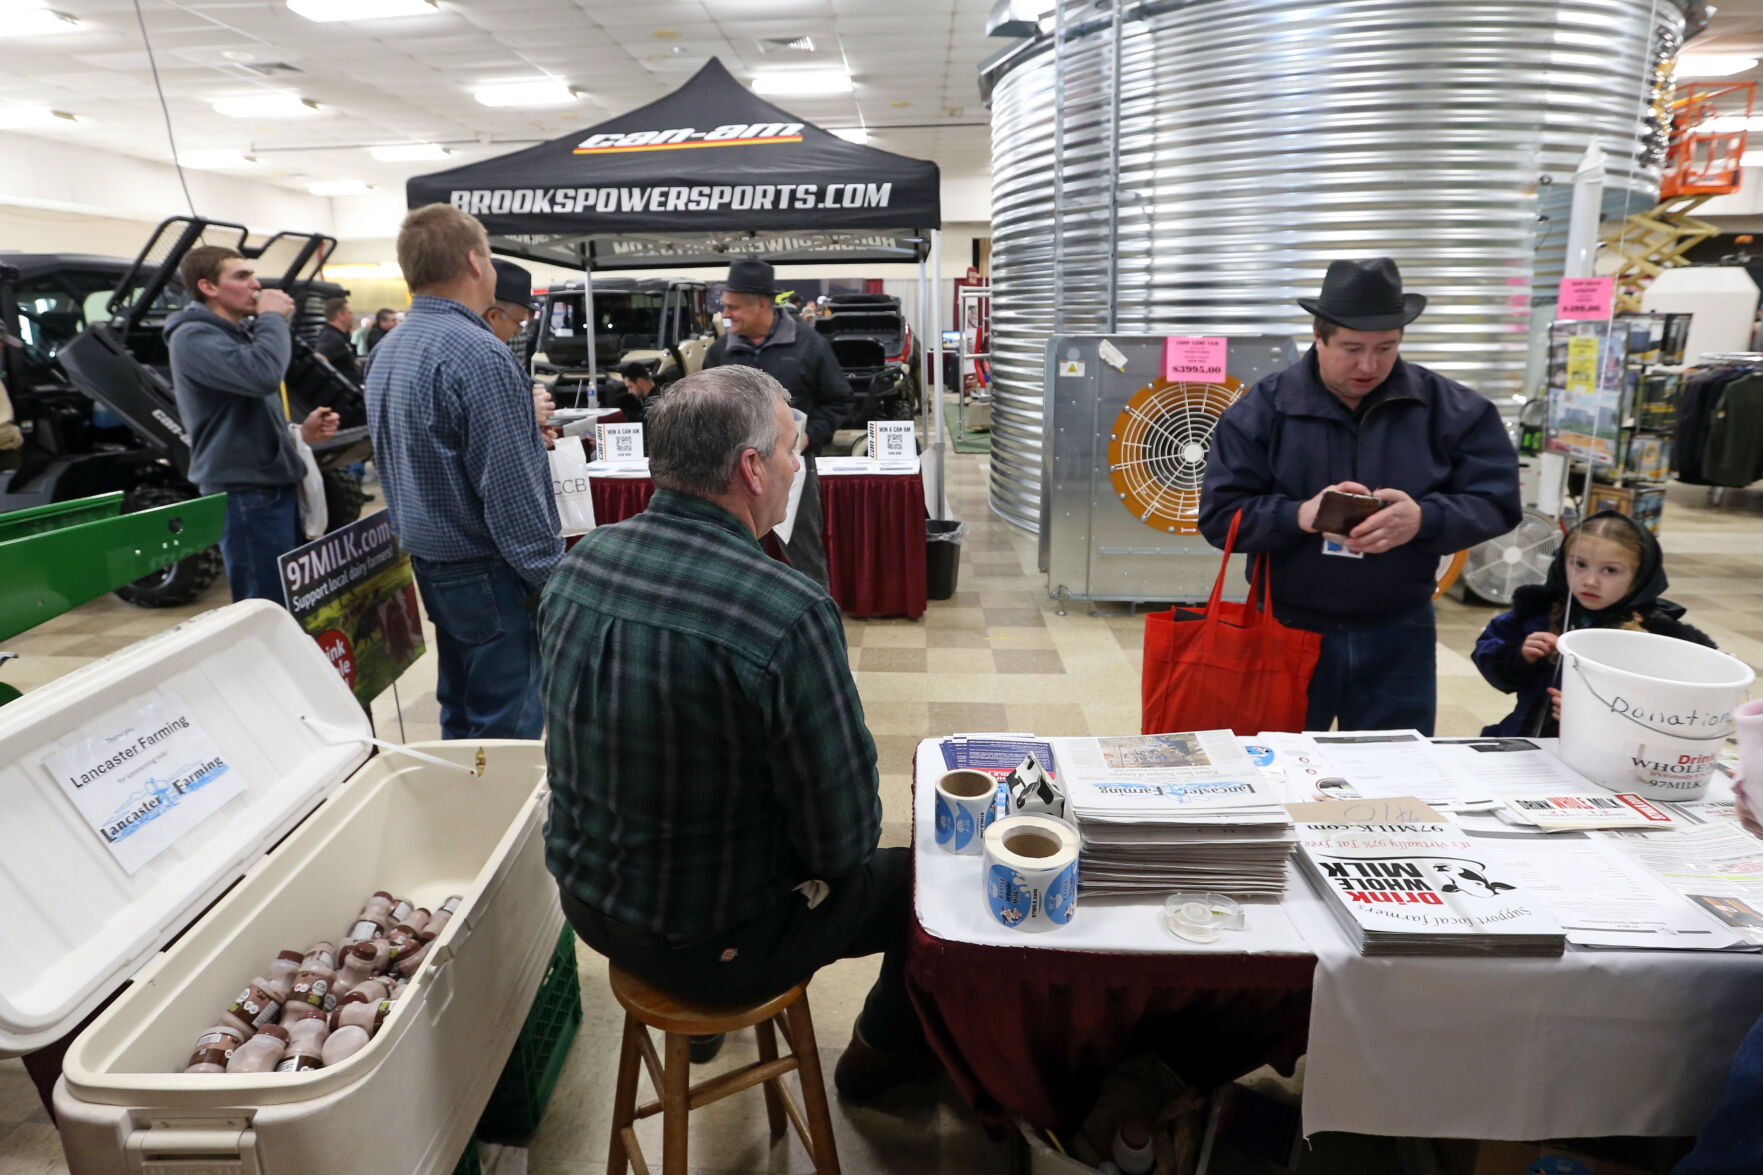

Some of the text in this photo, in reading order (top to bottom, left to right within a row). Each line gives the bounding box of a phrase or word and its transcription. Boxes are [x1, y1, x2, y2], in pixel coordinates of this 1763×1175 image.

[577, 121, 804, 149] can-am
[450, 182, 892, 216] BROOKSPOWERSPORTS.COM
[287, 522, 390, 591] 97MILK.com
[293, 544, 393, 612] Support local dairy farmers!
[70, 715, 190, 789] Lancaster Farming
[100, 756, 224, 843] Lancaster Farming
[1098, 783, 1257, 797] Lancaster Farming
[1306, 824, 1444, 833] 97MILK.com
[1318, 862, 1423, 878] MILK
[1334, 878, 1433, 891] WHOLE
[1346, 891, 1444, 906] Drink
[1357, 905, 1532, 928] Support local farmers
